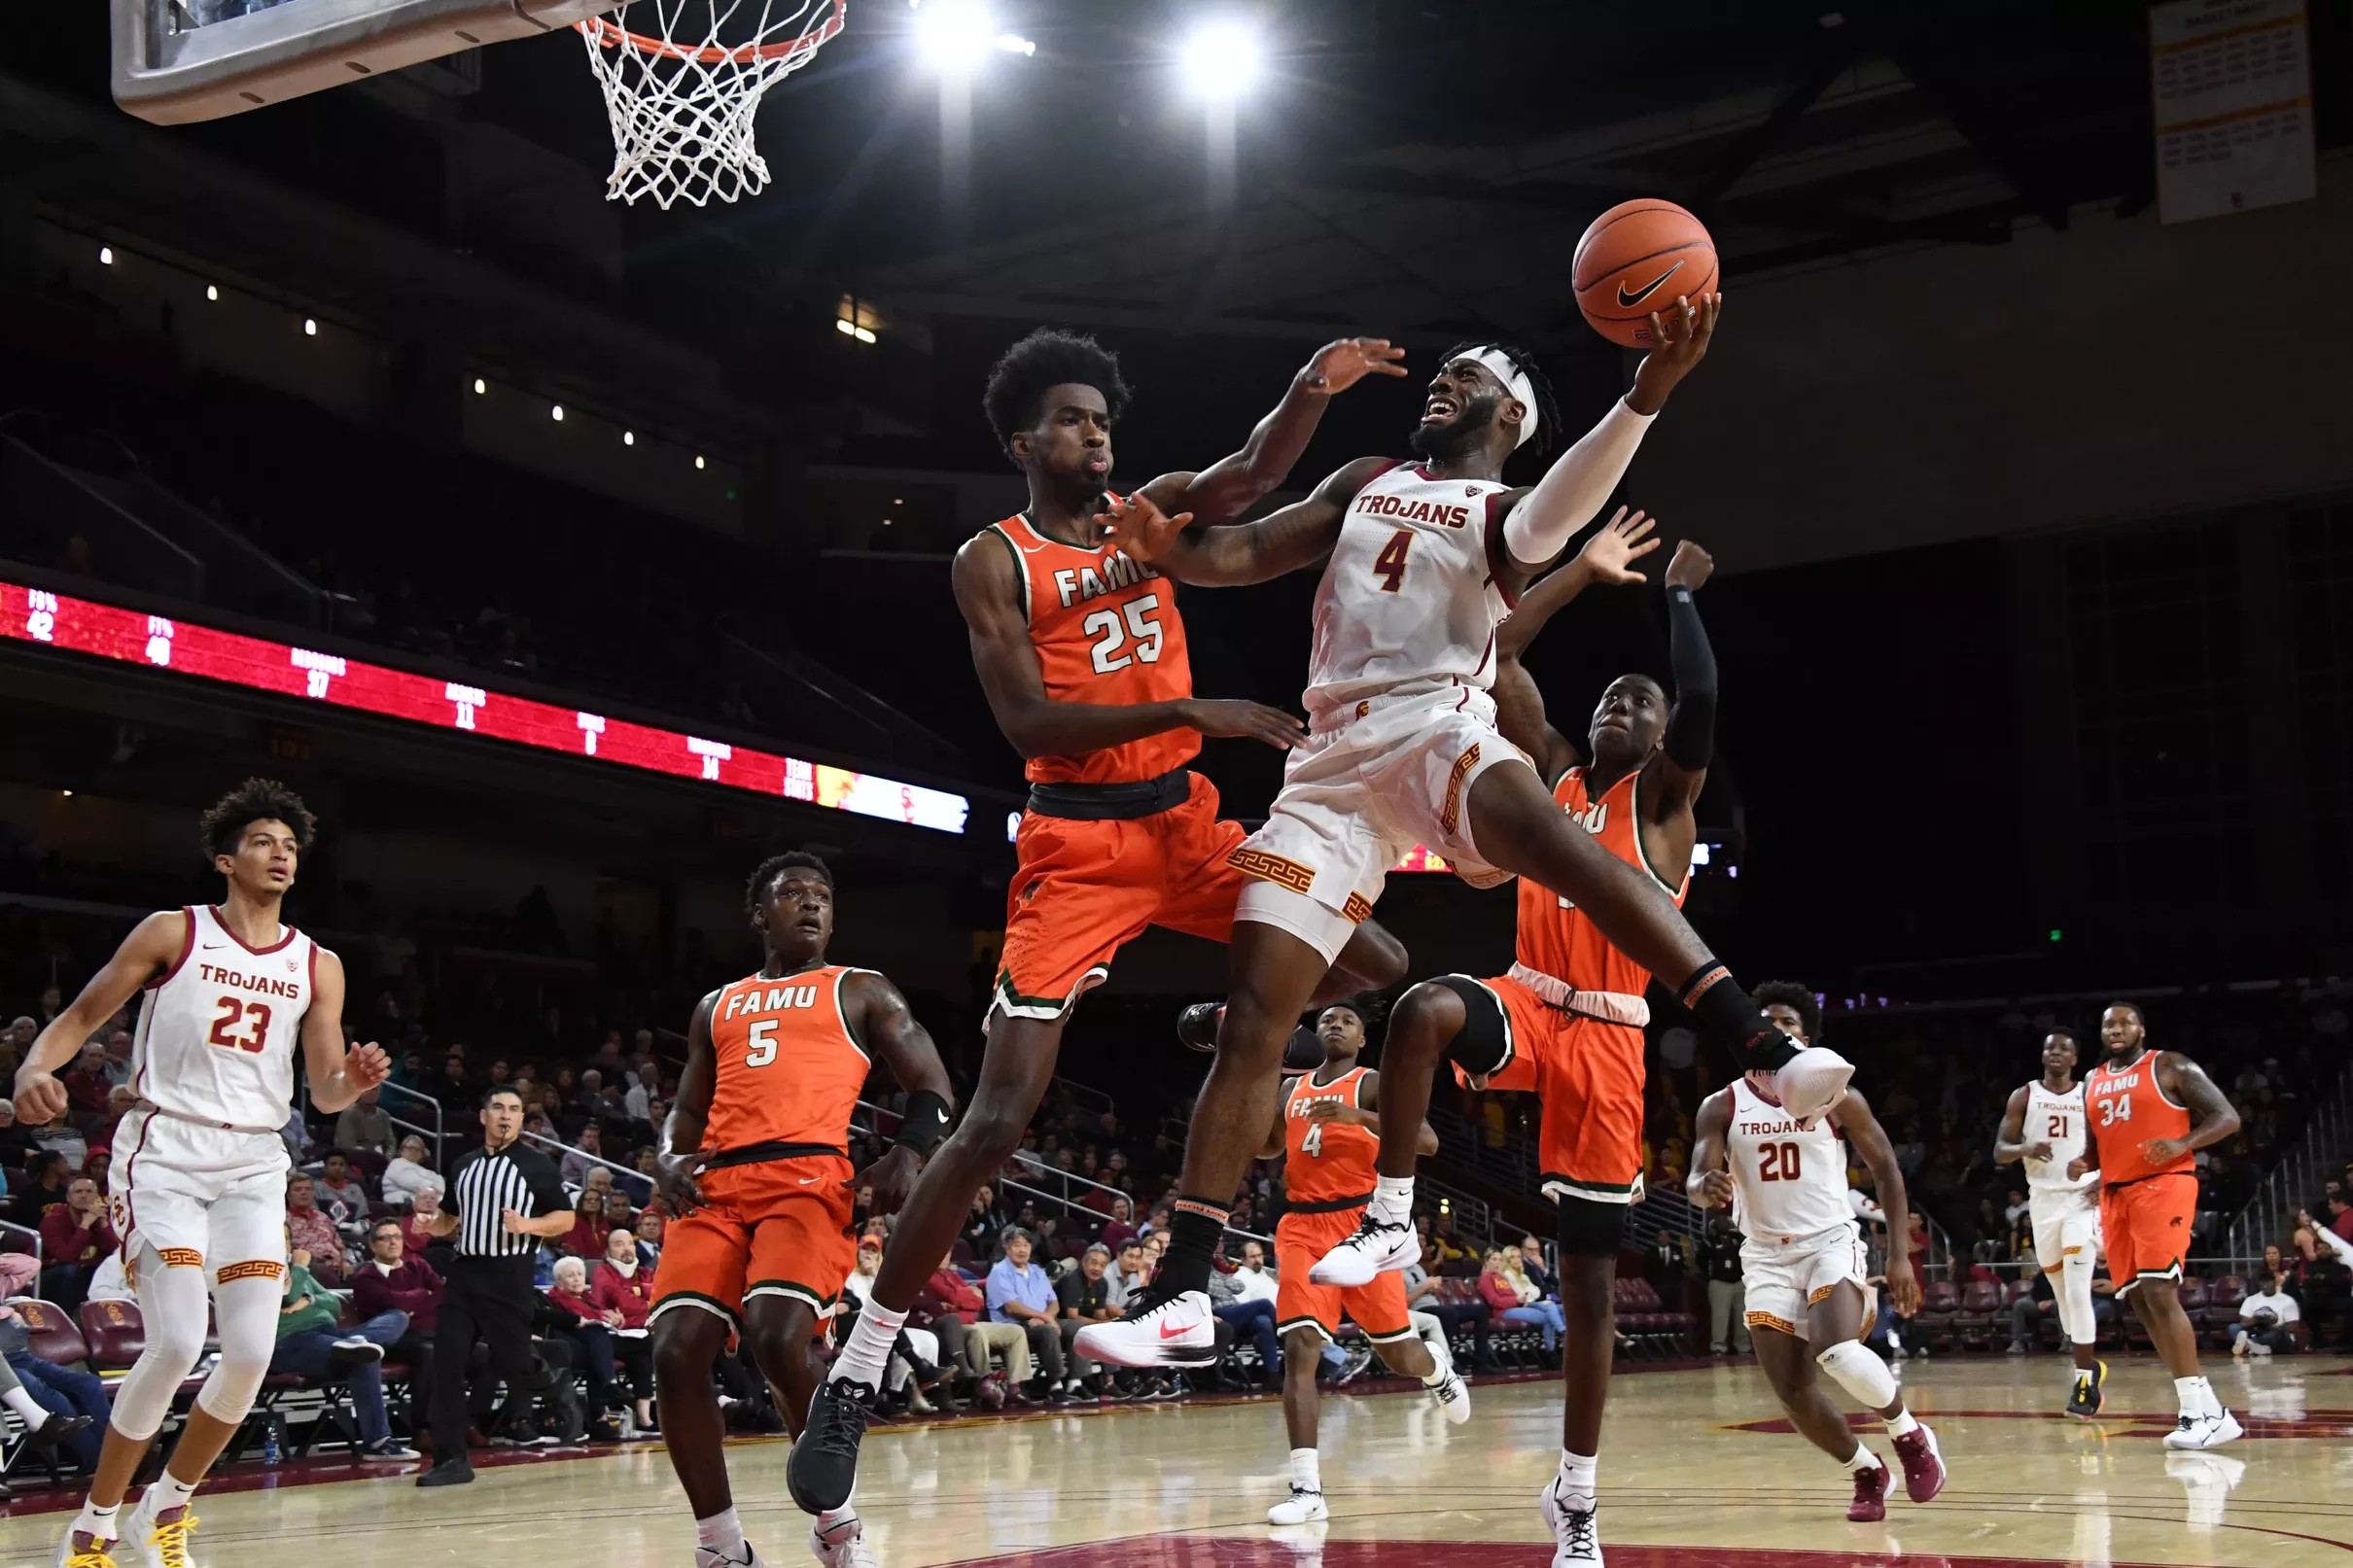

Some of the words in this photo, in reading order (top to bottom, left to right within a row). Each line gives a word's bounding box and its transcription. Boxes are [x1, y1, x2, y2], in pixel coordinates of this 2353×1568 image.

[1355, 495, 1469, 529] TROJANS
[1373, 529, 1416, 593] 4
[27, 610, 53, 642] 42
[1083, 593, 1164, 675] 25
[455, 701, 474, 729] 11
[199, 963, 299, 999] TROJANS
[724, 986, 818, 1021] FAMU
[209, 995, 272, 1054] 23
[745, 1019, 779, 1068] 5
[2093, 1073, 2139, 1098] FAMU
[2036, 1101, 2084, 1112] TROJANS
[2097, 1094, 2132, 1127] 34
[1301, 1123, 1321, 1158] 4
[2048, 1115, 2069, 1138] 21
[1757, 1141, 1801, 1182] 20
